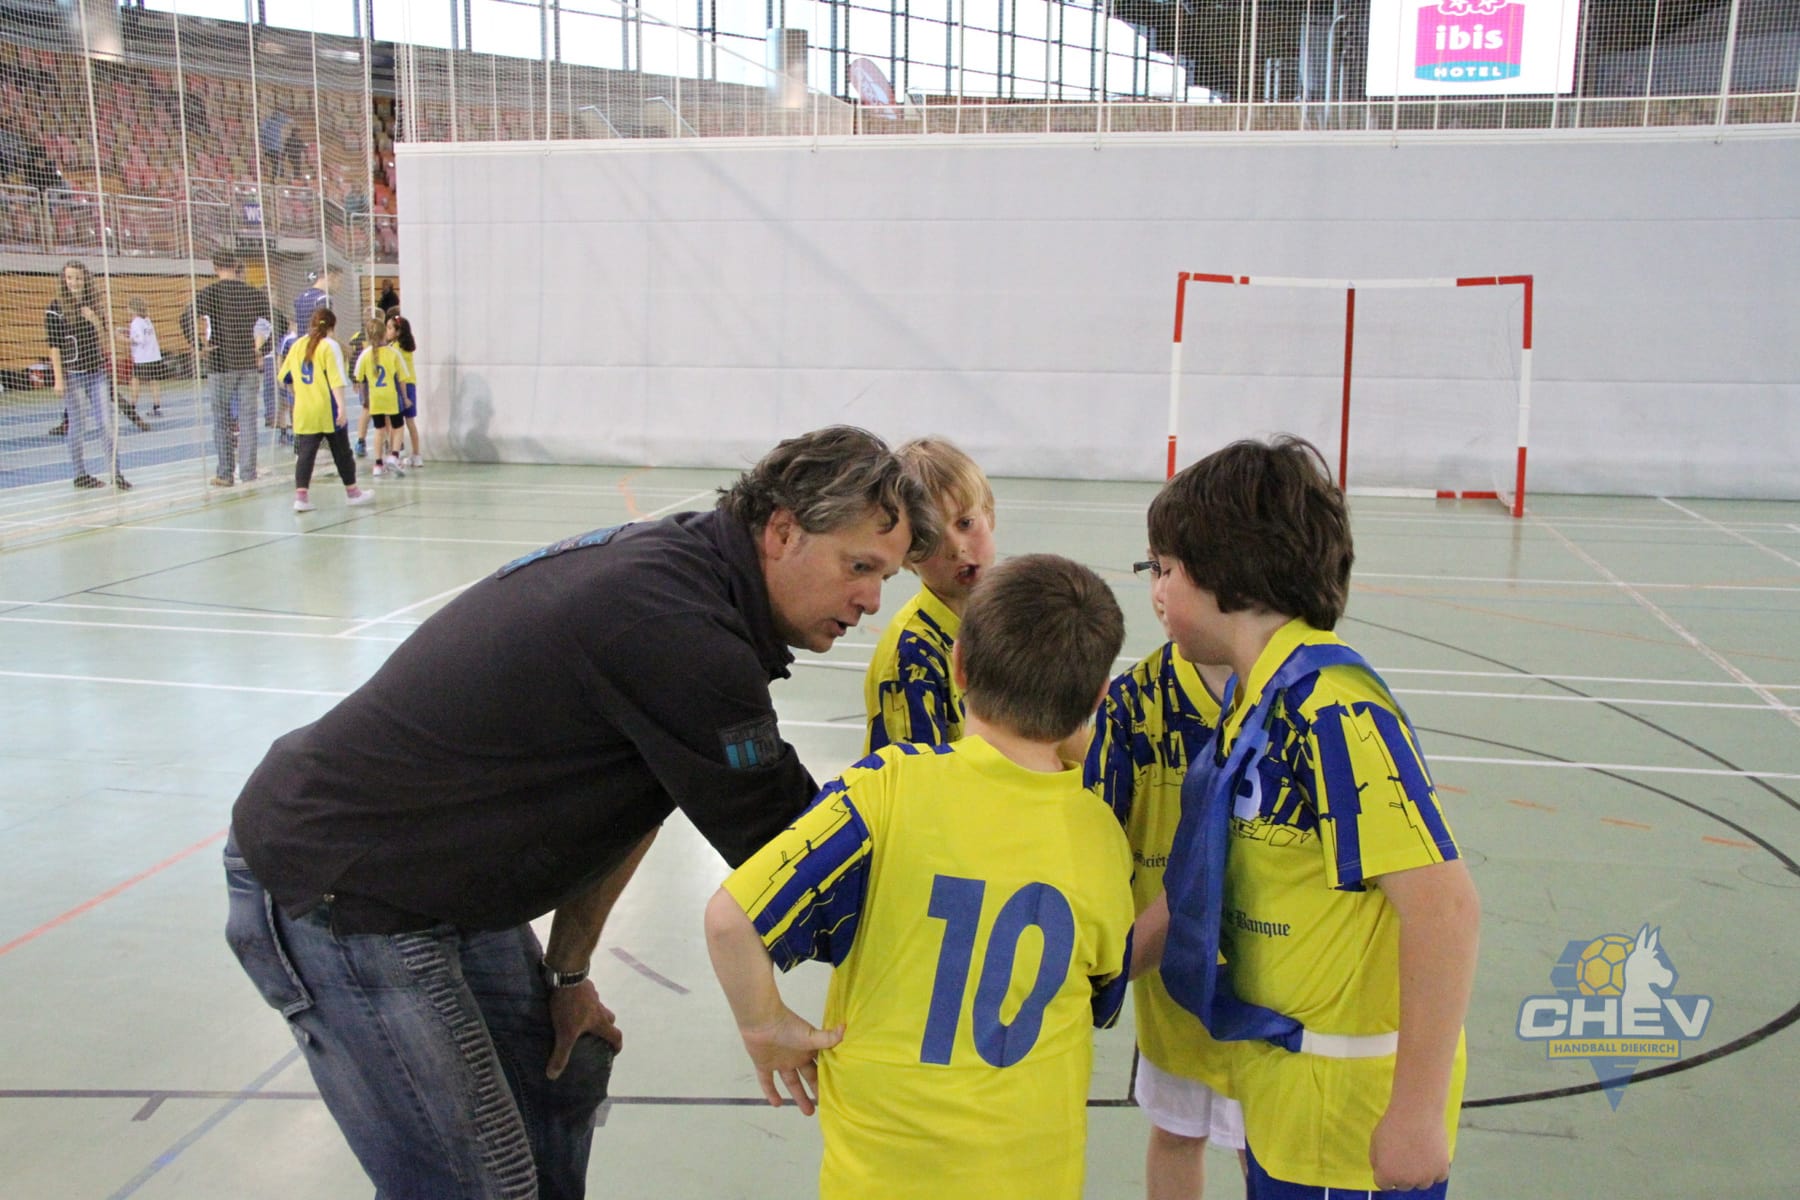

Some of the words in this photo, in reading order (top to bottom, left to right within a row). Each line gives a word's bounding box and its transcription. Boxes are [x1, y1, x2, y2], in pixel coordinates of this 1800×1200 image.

[1435, 24, 1503, 50] ibis
[1433, 66, 1502, 78] HOTEL
[301, 360, 314, 385] 9
[375, 365, 387, 387] 2
[1235, 910, 1291, 938] Banque
[920, 874, 1075, 1068] 10
